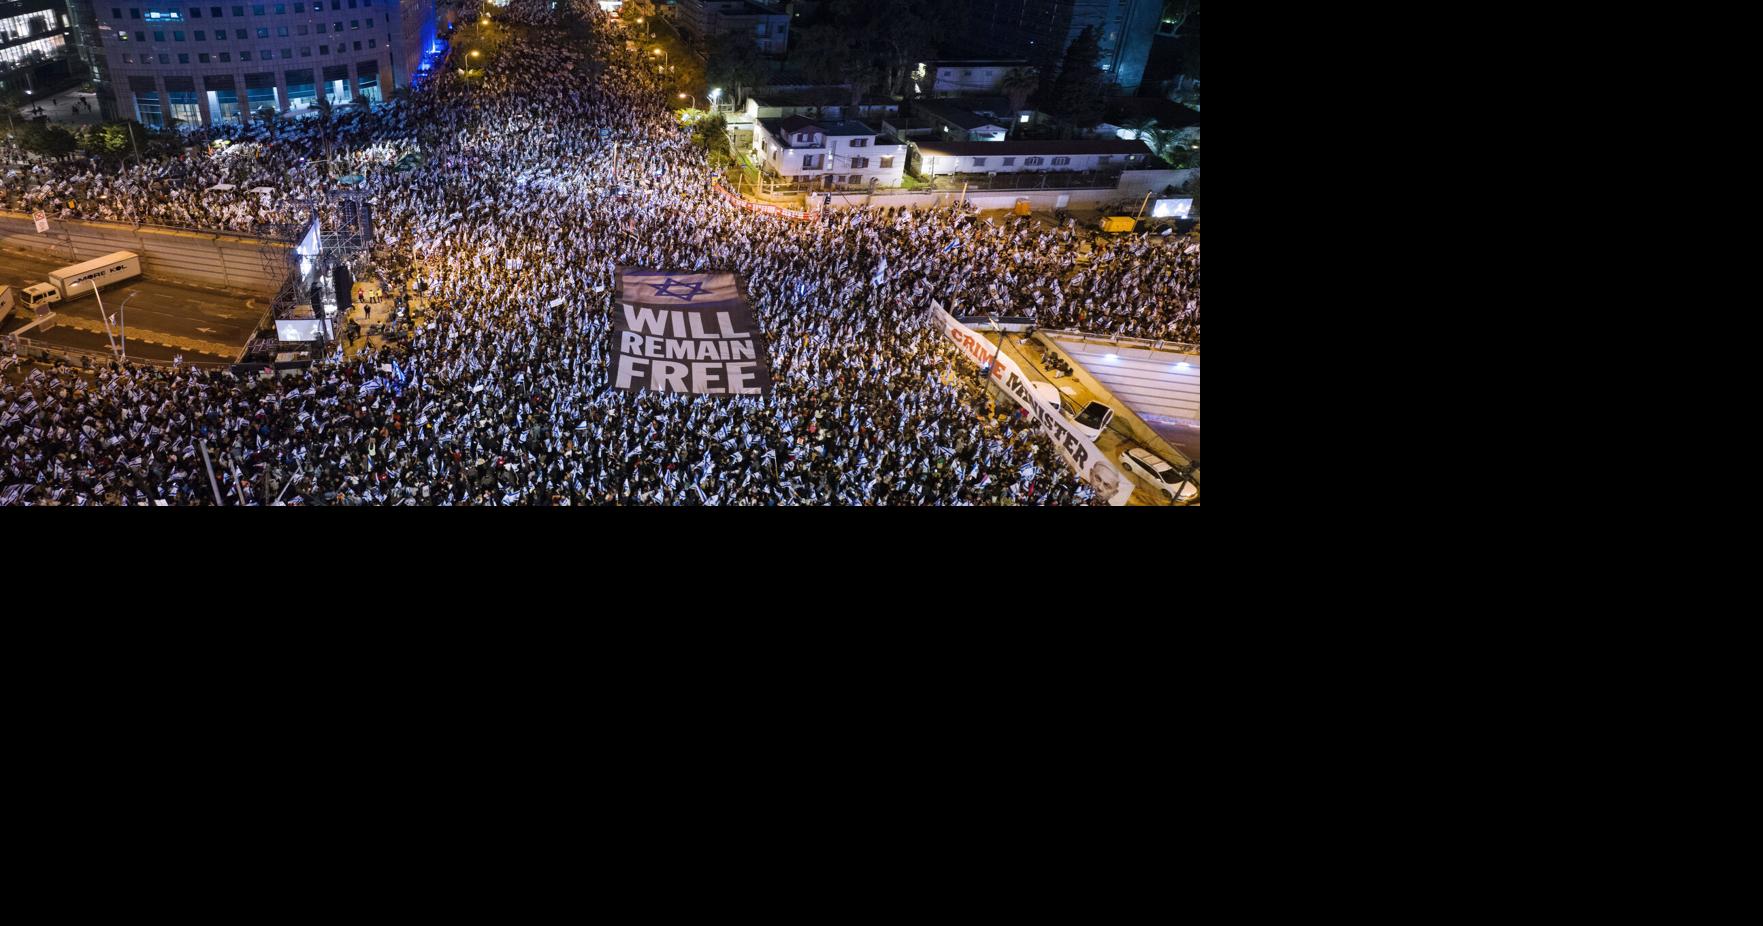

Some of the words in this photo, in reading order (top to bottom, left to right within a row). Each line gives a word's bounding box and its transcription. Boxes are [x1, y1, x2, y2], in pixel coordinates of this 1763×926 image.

[109, 264, 127, 273] KOL
[622, 304, 750, 339] WILL
[620, 331, 757, 360] REMAIN
[615, 354, 761, 394] FREE
[951, 328, 1007, 380] CRIME
[1006, 372, 1088, 470] MINISTER
